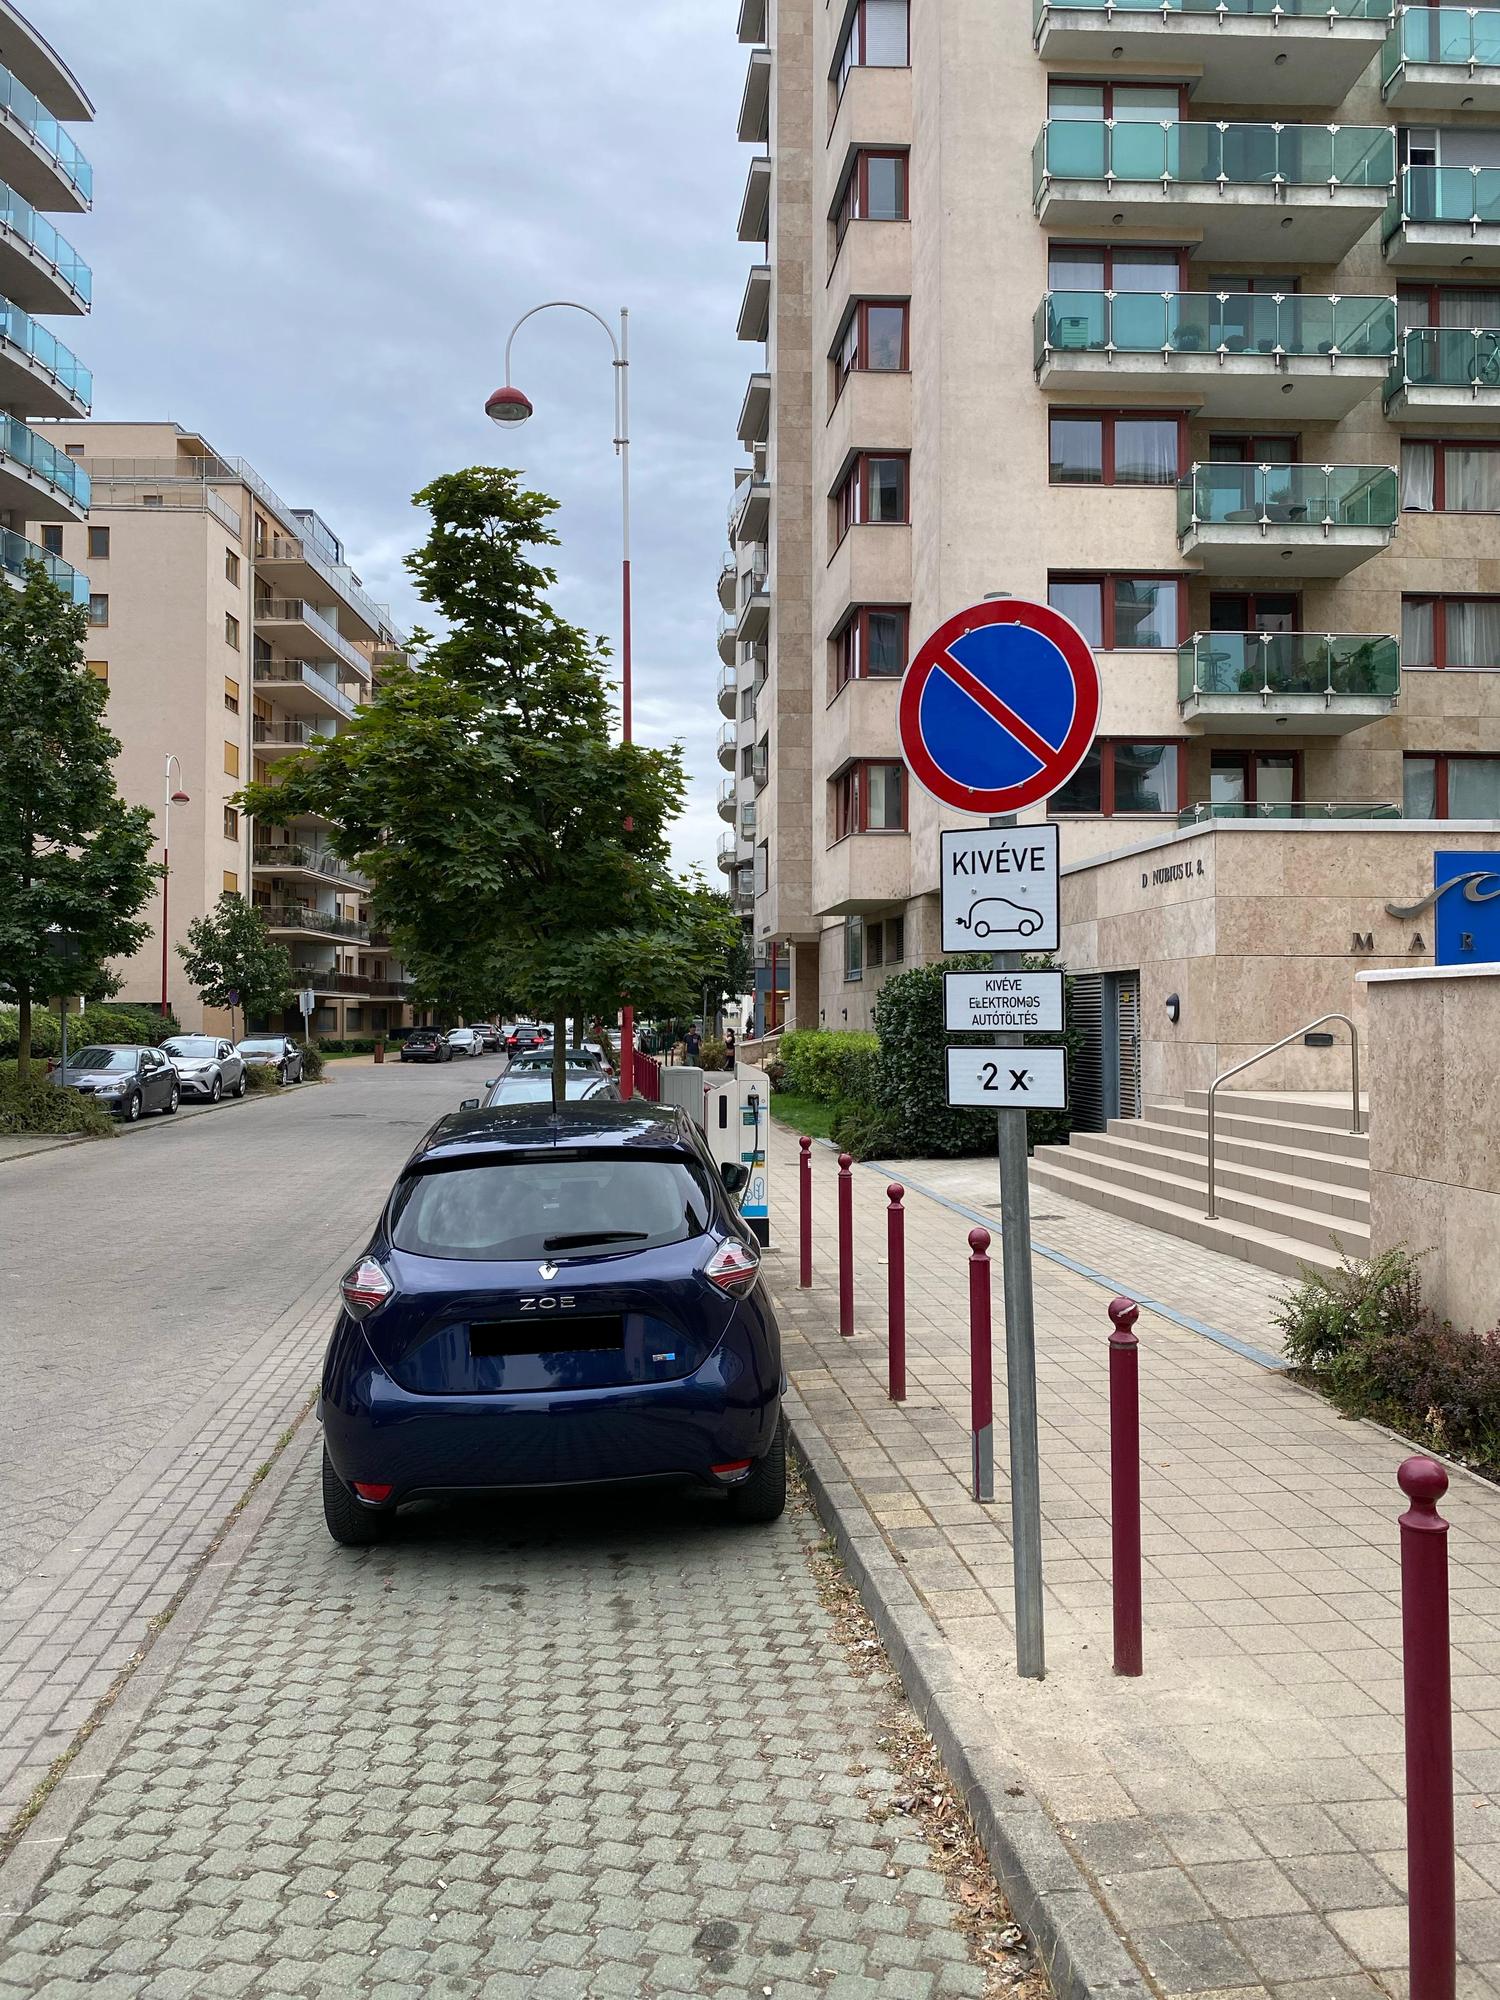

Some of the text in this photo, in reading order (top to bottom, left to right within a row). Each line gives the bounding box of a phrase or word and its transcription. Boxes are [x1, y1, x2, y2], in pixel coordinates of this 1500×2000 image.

[952, 841, 1046, 876] KIVÉVE
[985, 977, 1022, 992] KIVÉVE
[969, 996, 1041, 1009] ELEKTROMOS
[971, 1009, 1038, 1026] AUTÓTÖLTÉS
[982, 1062, 999, 1091] 2
[519, 1296, 576, 1311] ZOE
